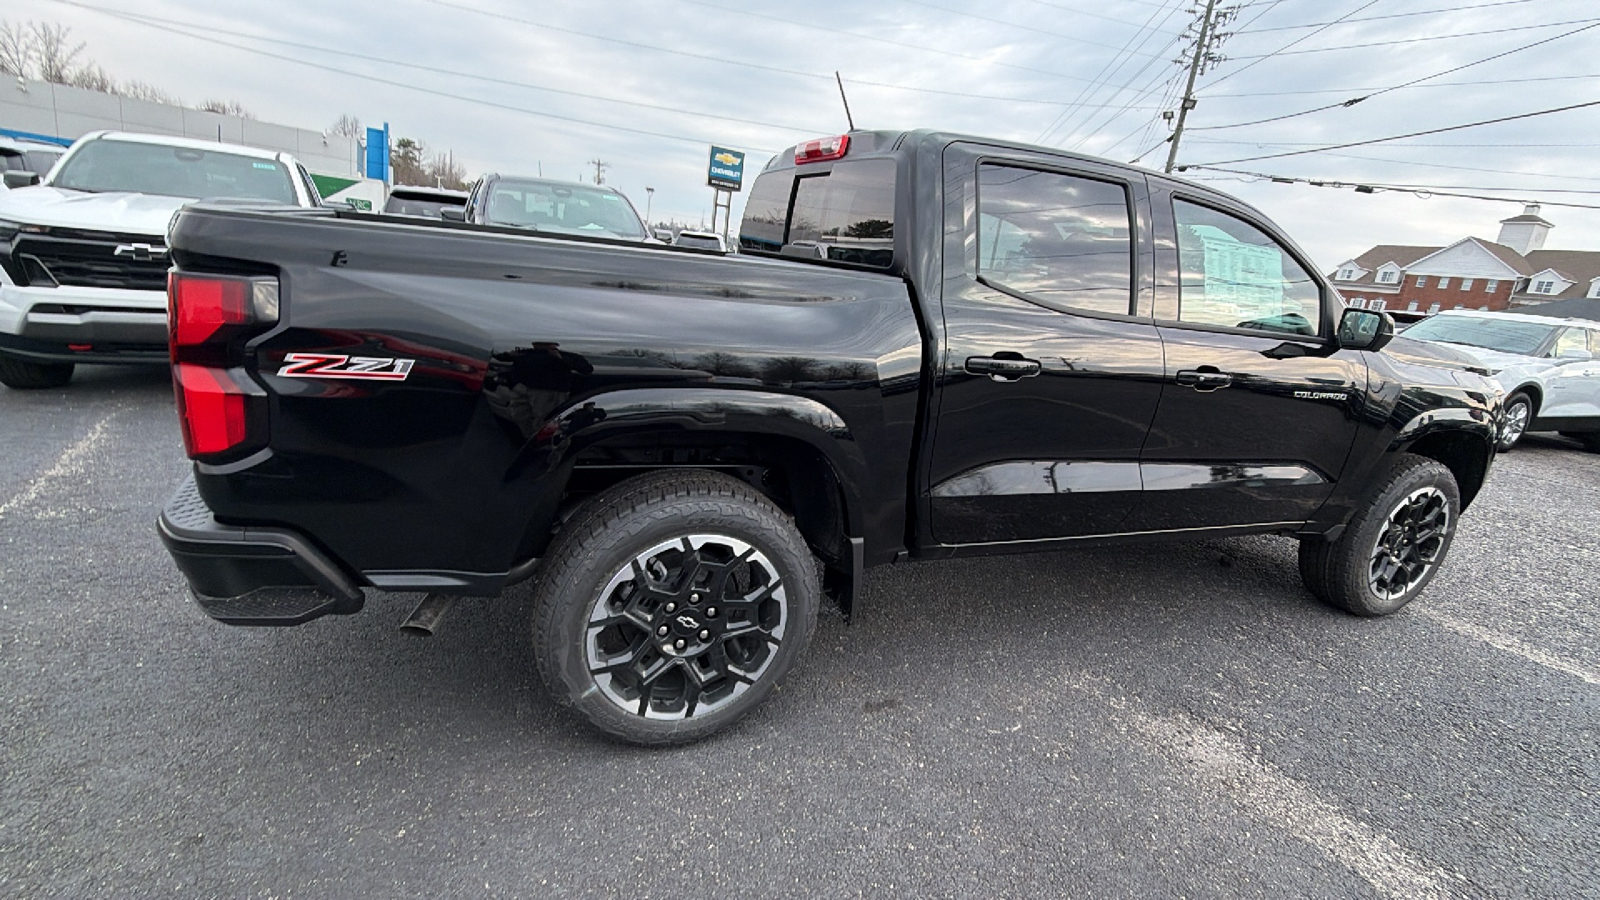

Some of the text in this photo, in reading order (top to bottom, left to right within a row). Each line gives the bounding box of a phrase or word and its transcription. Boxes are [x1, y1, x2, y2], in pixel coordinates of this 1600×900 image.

[711, 167, 741, 178] CHEVROLET
[277, 352, 415, 381] Z71
[1293, 391, 1348, 401] COLORADO
